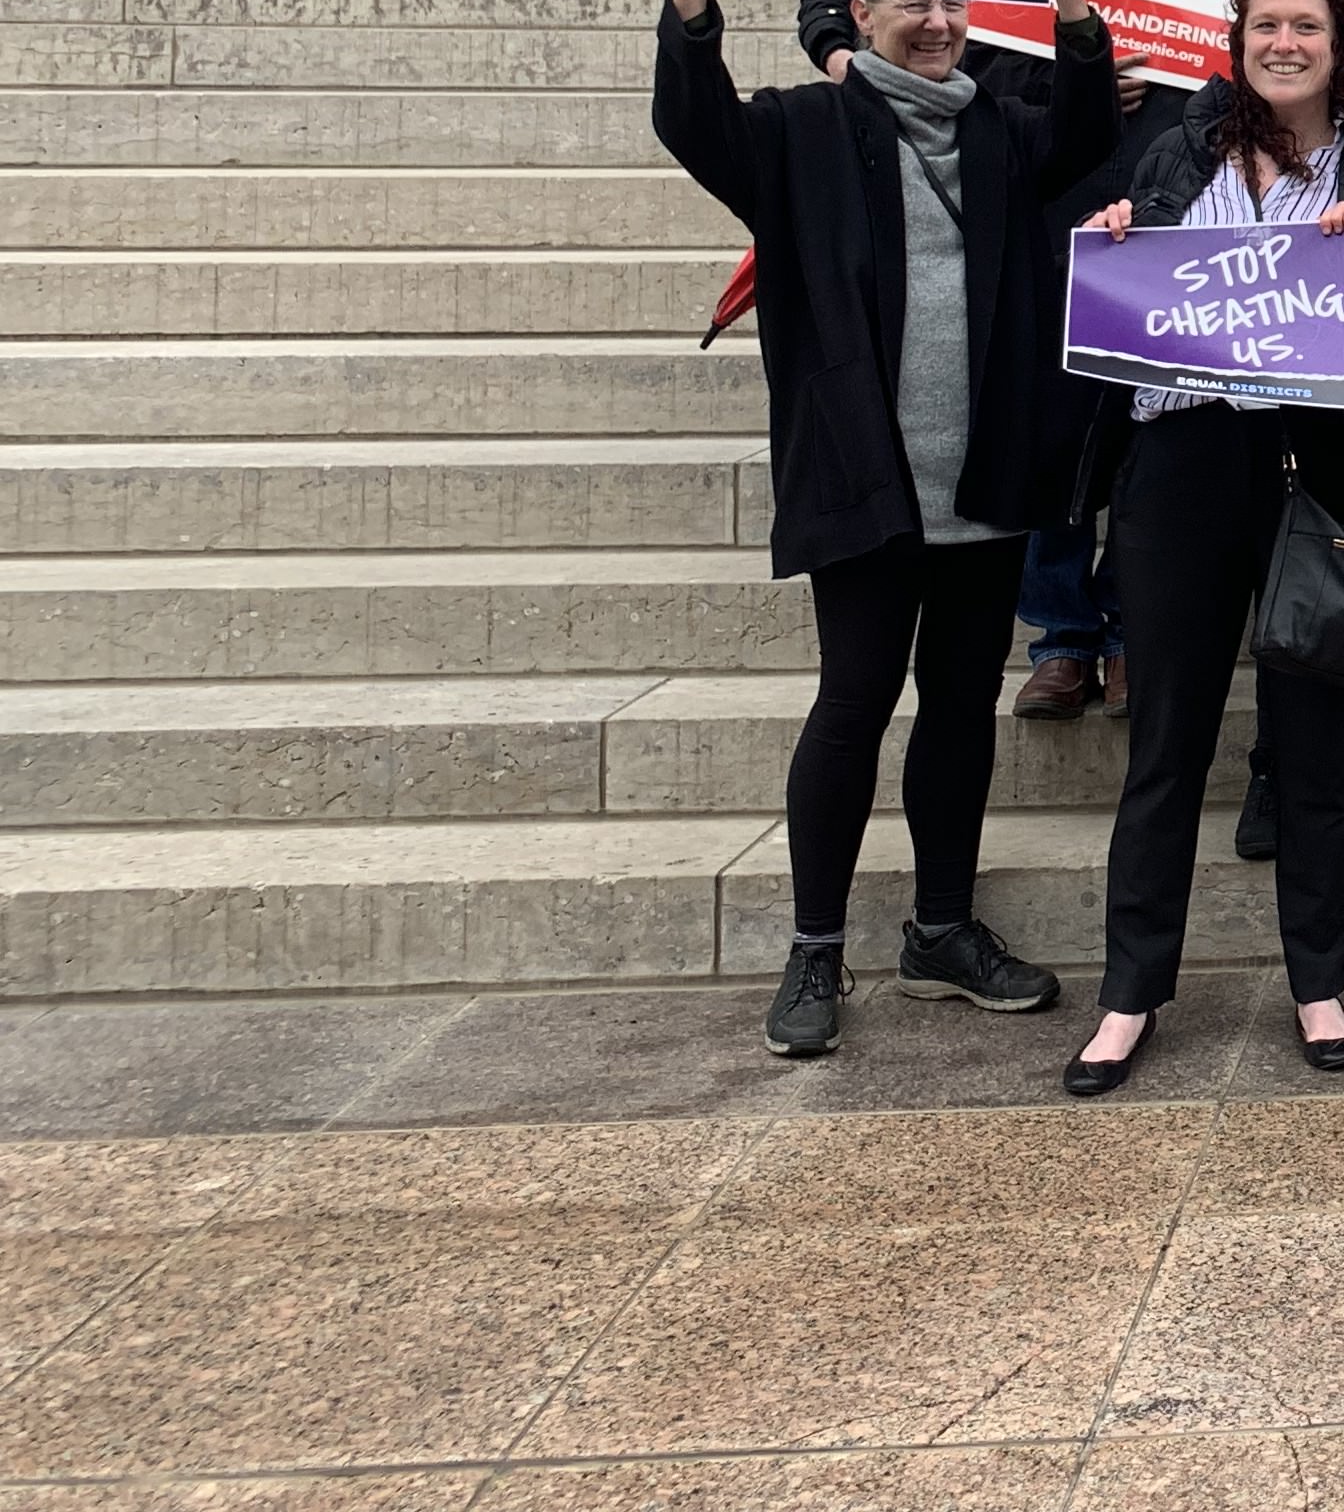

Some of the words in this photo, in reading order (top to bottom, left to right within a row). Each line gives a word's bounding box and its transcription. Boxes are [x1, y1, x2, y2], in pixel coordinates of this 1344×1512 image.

[1173, 234, 1292, 292] STOP
[1233, 333, 1303, 367] US.
[1177, 376, 1227, 390] EQUAL
[1229, 382, 1312, 398] DISTRICTS
